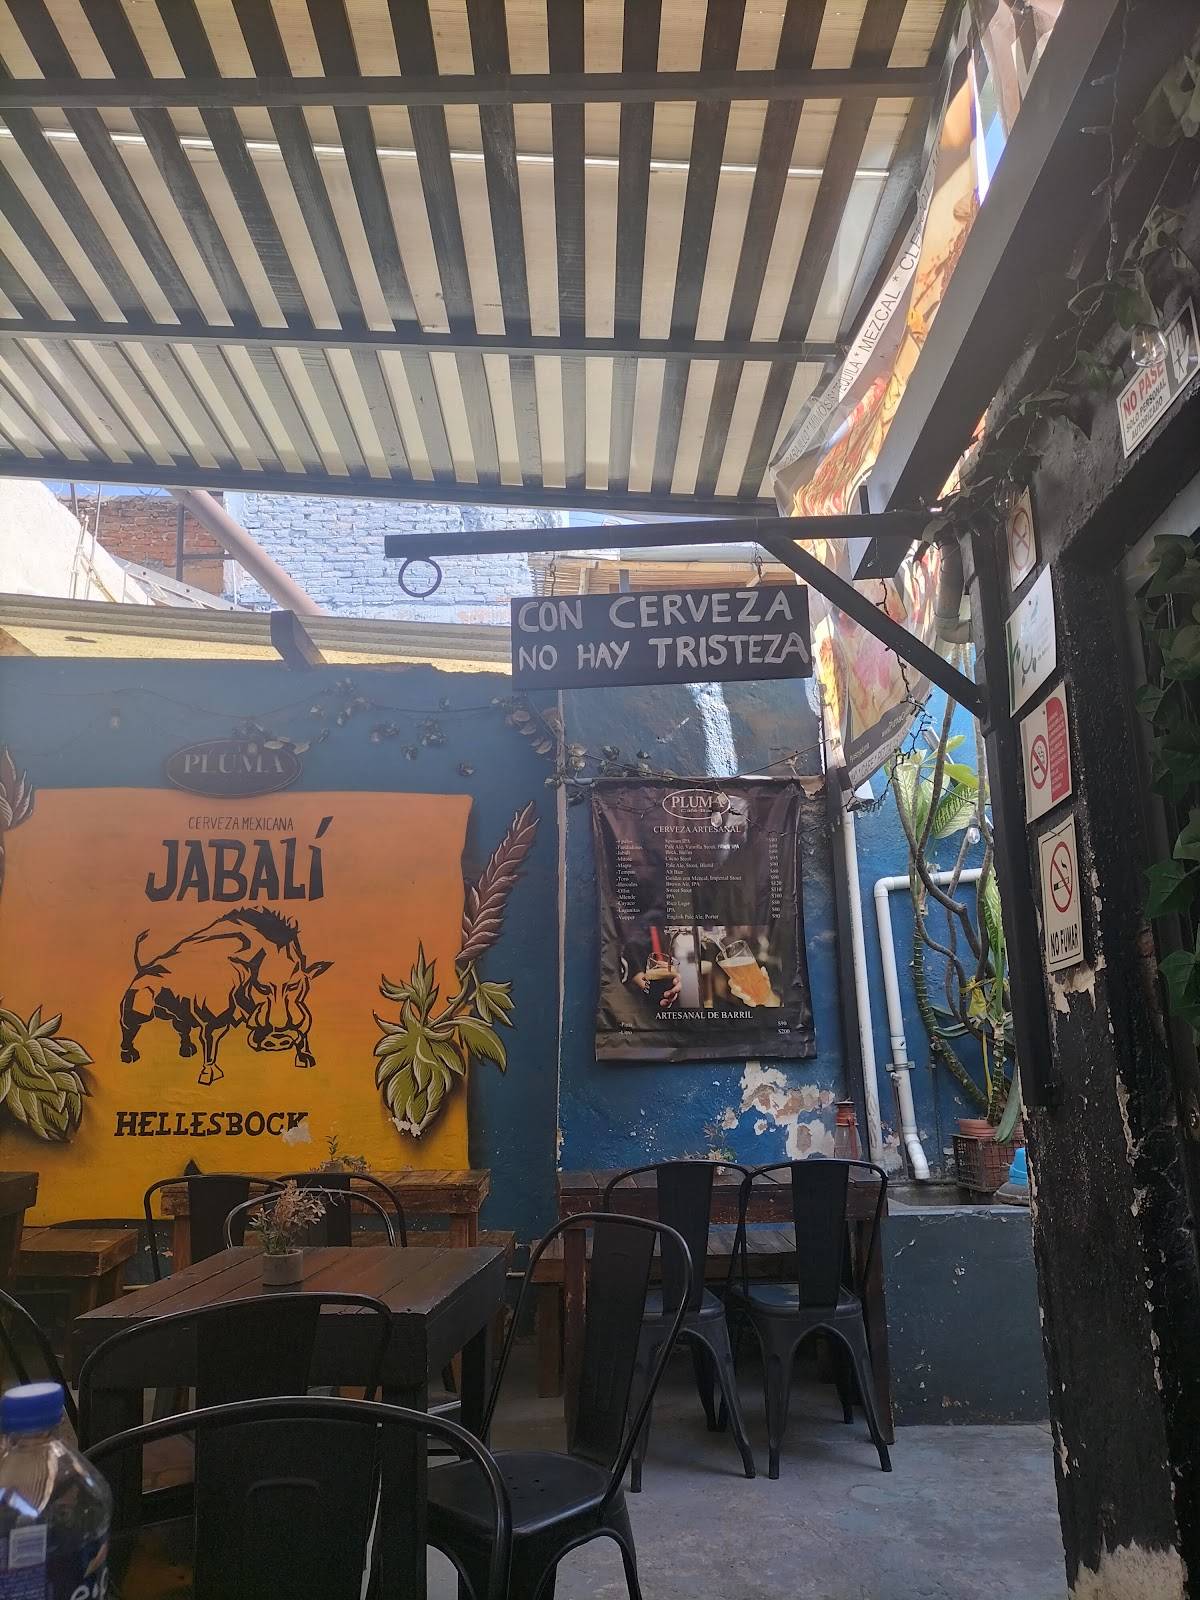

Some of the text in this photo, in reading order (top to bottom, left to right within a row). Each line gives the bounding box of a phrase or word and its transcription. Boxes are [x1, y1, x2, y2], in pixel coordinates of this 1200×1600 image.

[859, 291, 900, 352] MEZCAL
[1123, 390, 1138, 418] NO
[1126, 379, 1167, 433] SOLO PERSONAL
[1131, 395, 1163, 441] AUTORIZADO
[518, 590, 793, 632] CON CERVEZA
[518, 631, 809, 671] NO HAY TRISTEZA
[183, 753, 284, 774] PLUMA
[672, 796, 724, 808] PLUMA
[188, 816, 294, 832] CERVEZA MEXICANA
[692, 825, 741, 833] ARTESANAL
[145, 815, 334, 902] JABALÍ
[1050, 923, 1079, 957] NO FUMAR
[656, 1012, 705, 1020] ARTESANAL
[721, 1011, 753, 1019] BARRIL
[114, 1111, 309, 1137] HELLESBOCK
